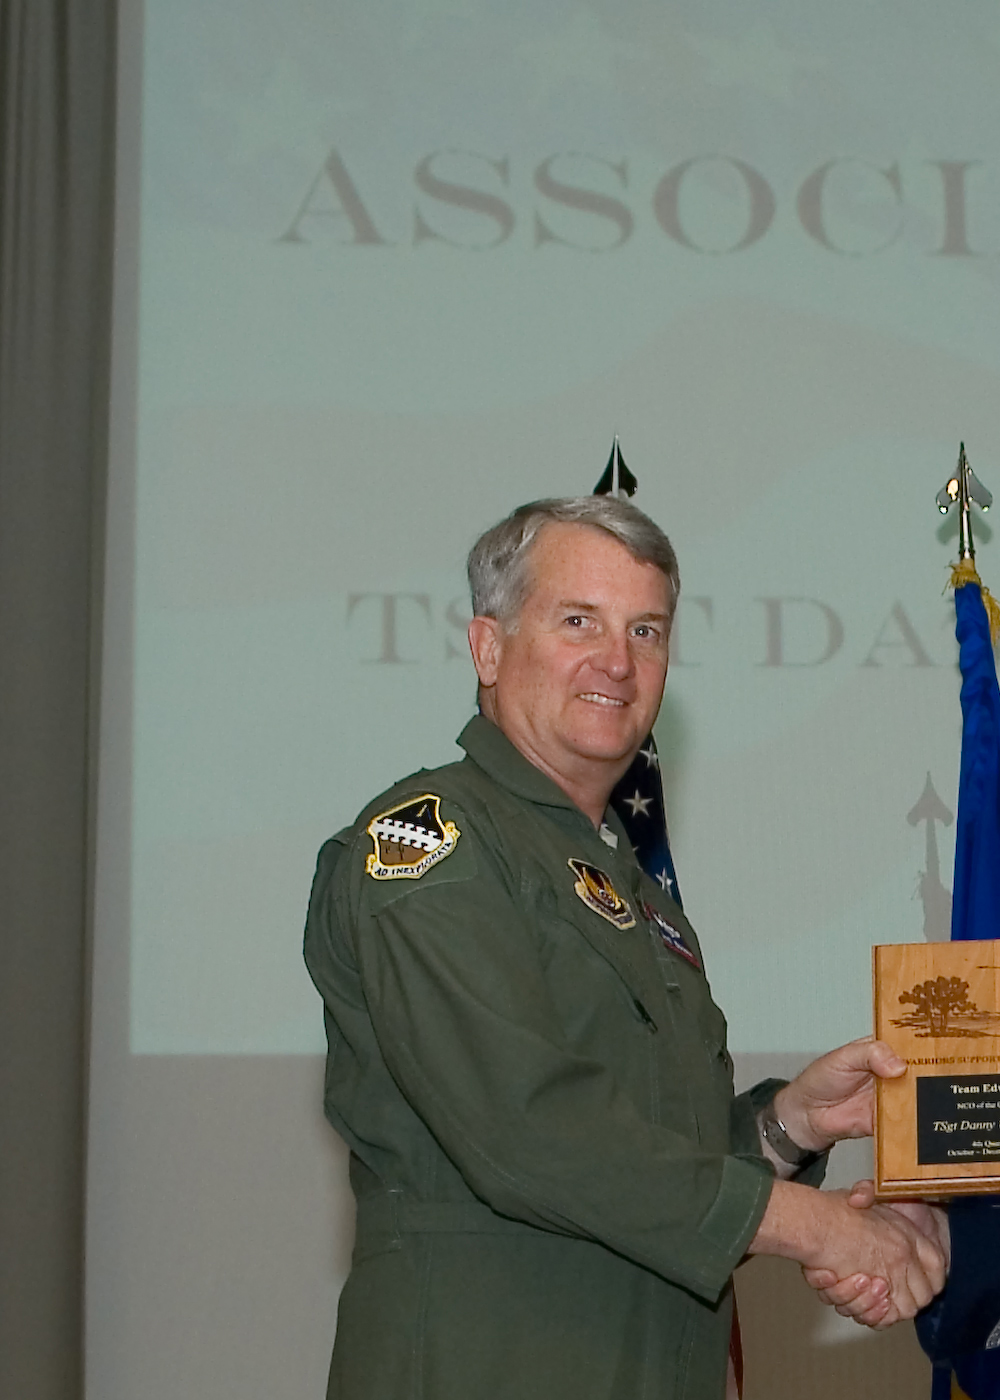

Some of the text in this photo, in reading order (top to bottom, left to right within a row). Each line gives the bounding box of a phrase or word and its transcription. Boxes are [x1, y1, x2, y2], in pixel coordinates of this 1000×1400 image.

[345, 591, 714, 668] TT
[950, 1084, 980, 1094] Team
[957, 1102, 976, 1110] NCO
[976, 1101, 985, 1109] of
[985, 1101, 996, 1109] the
[933, 1120, 958, 1133] TSgt
[960, 1120, 996, 1132] Danny
